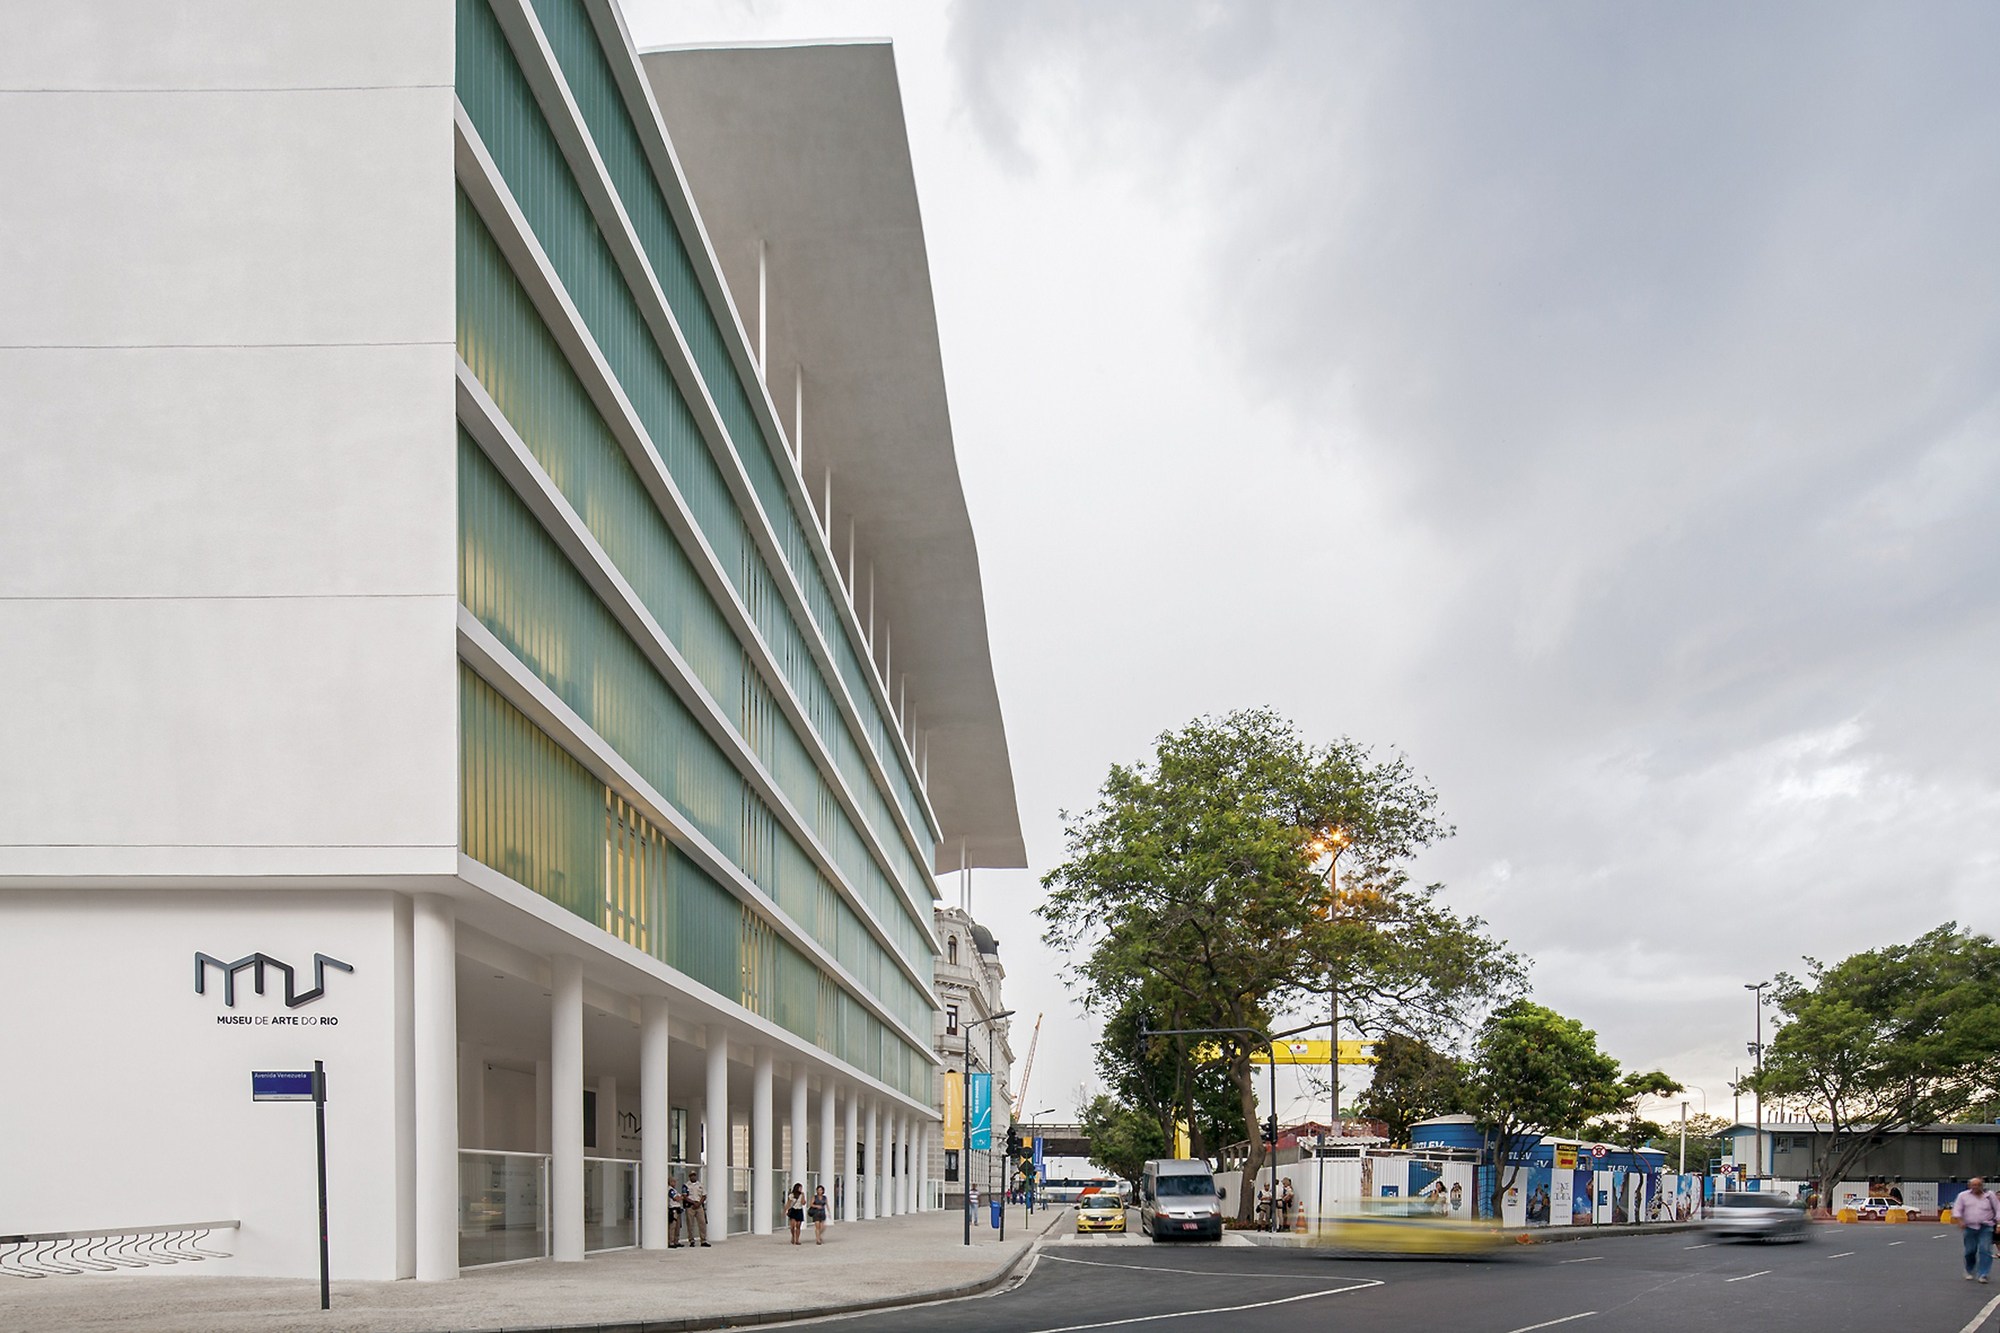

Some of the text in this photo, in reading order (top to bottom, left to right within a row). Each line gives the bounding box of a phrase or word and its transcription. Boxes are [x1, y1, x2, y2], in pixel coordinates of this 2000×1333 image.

[217, 1016, 339, 1026] MUSEU DE ARTE DO RIO
